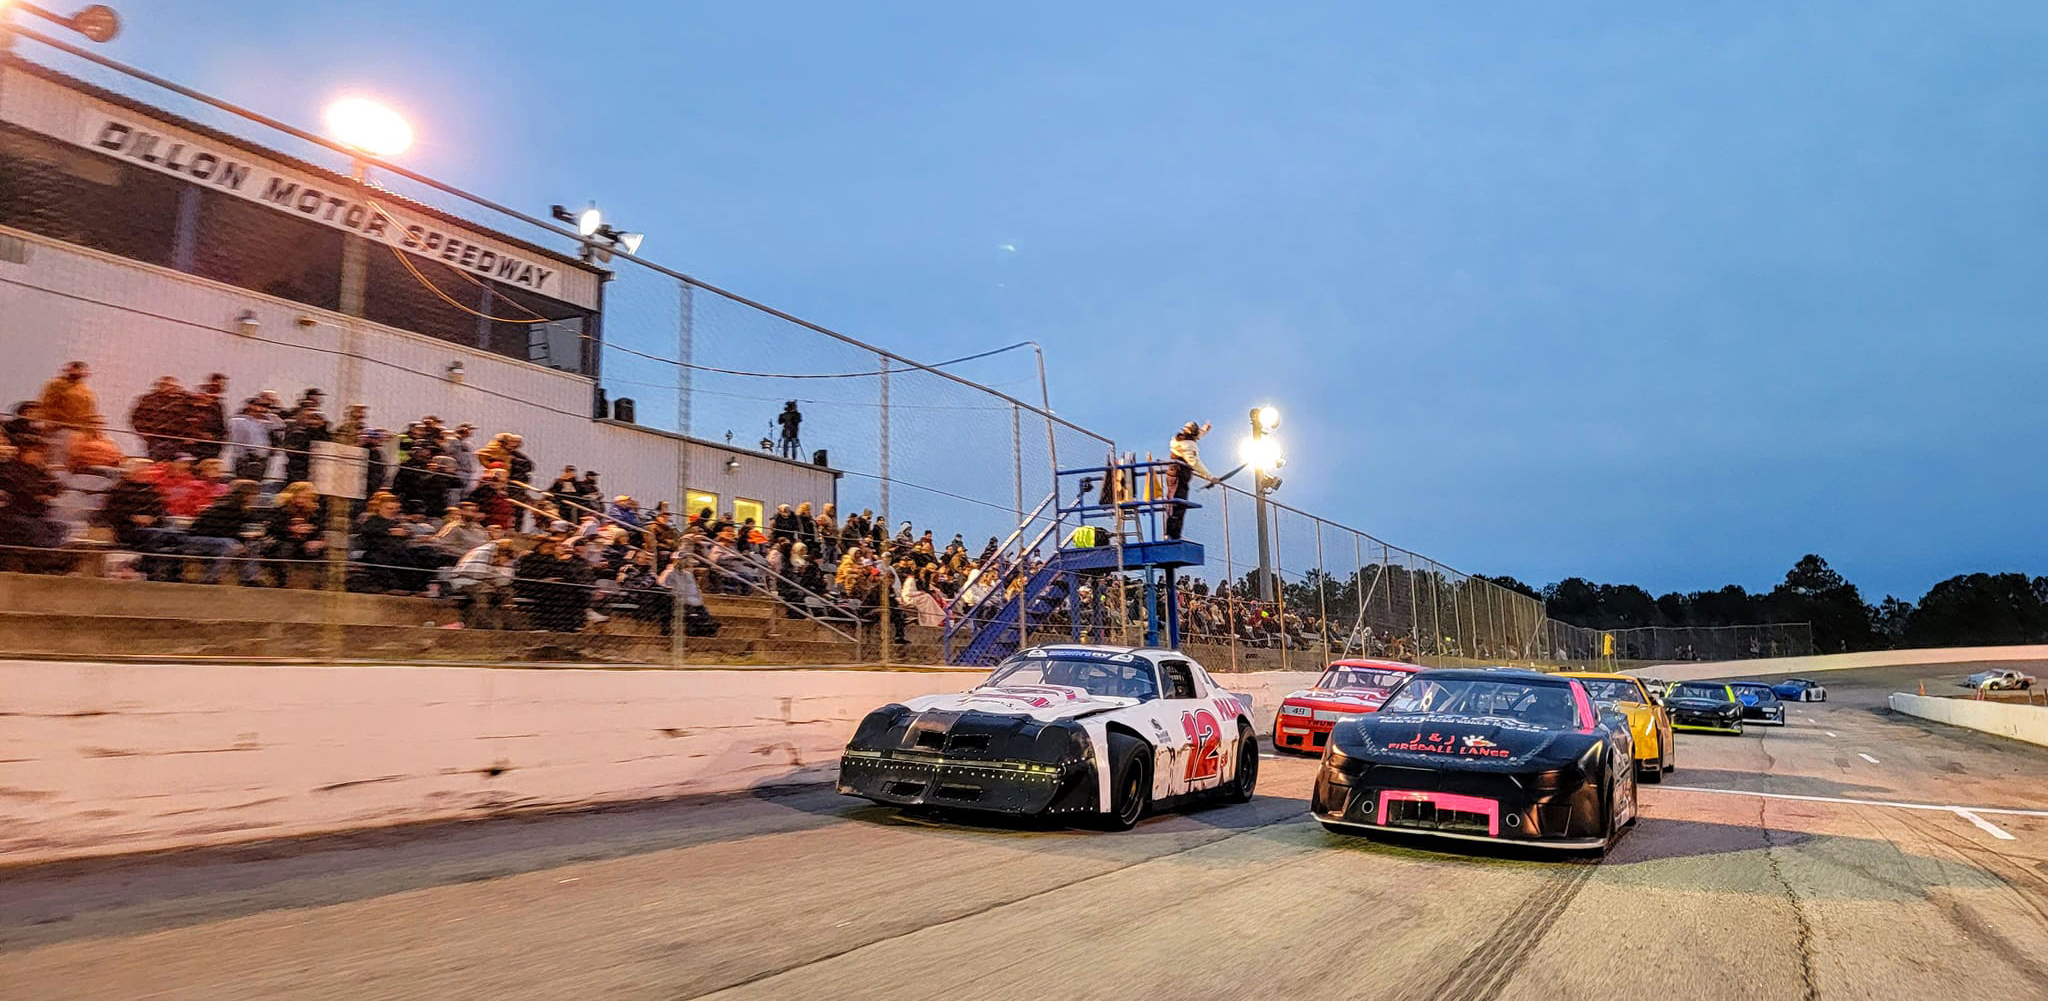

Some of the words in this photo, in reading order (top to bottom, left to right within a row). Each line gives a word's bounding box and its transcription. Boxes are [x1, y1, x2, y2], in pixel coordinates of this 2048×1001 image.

[94, 121, 250, 190] DILLON
[260, 177, 388, 238] MOTOR
[401, 224, 552, 289] SPEEDWAY
[1181, 708, 1223, 783] 12
[1388, 742, 1454, 755] FIREBALL
[1459, 746, 1510, 758] LANES
